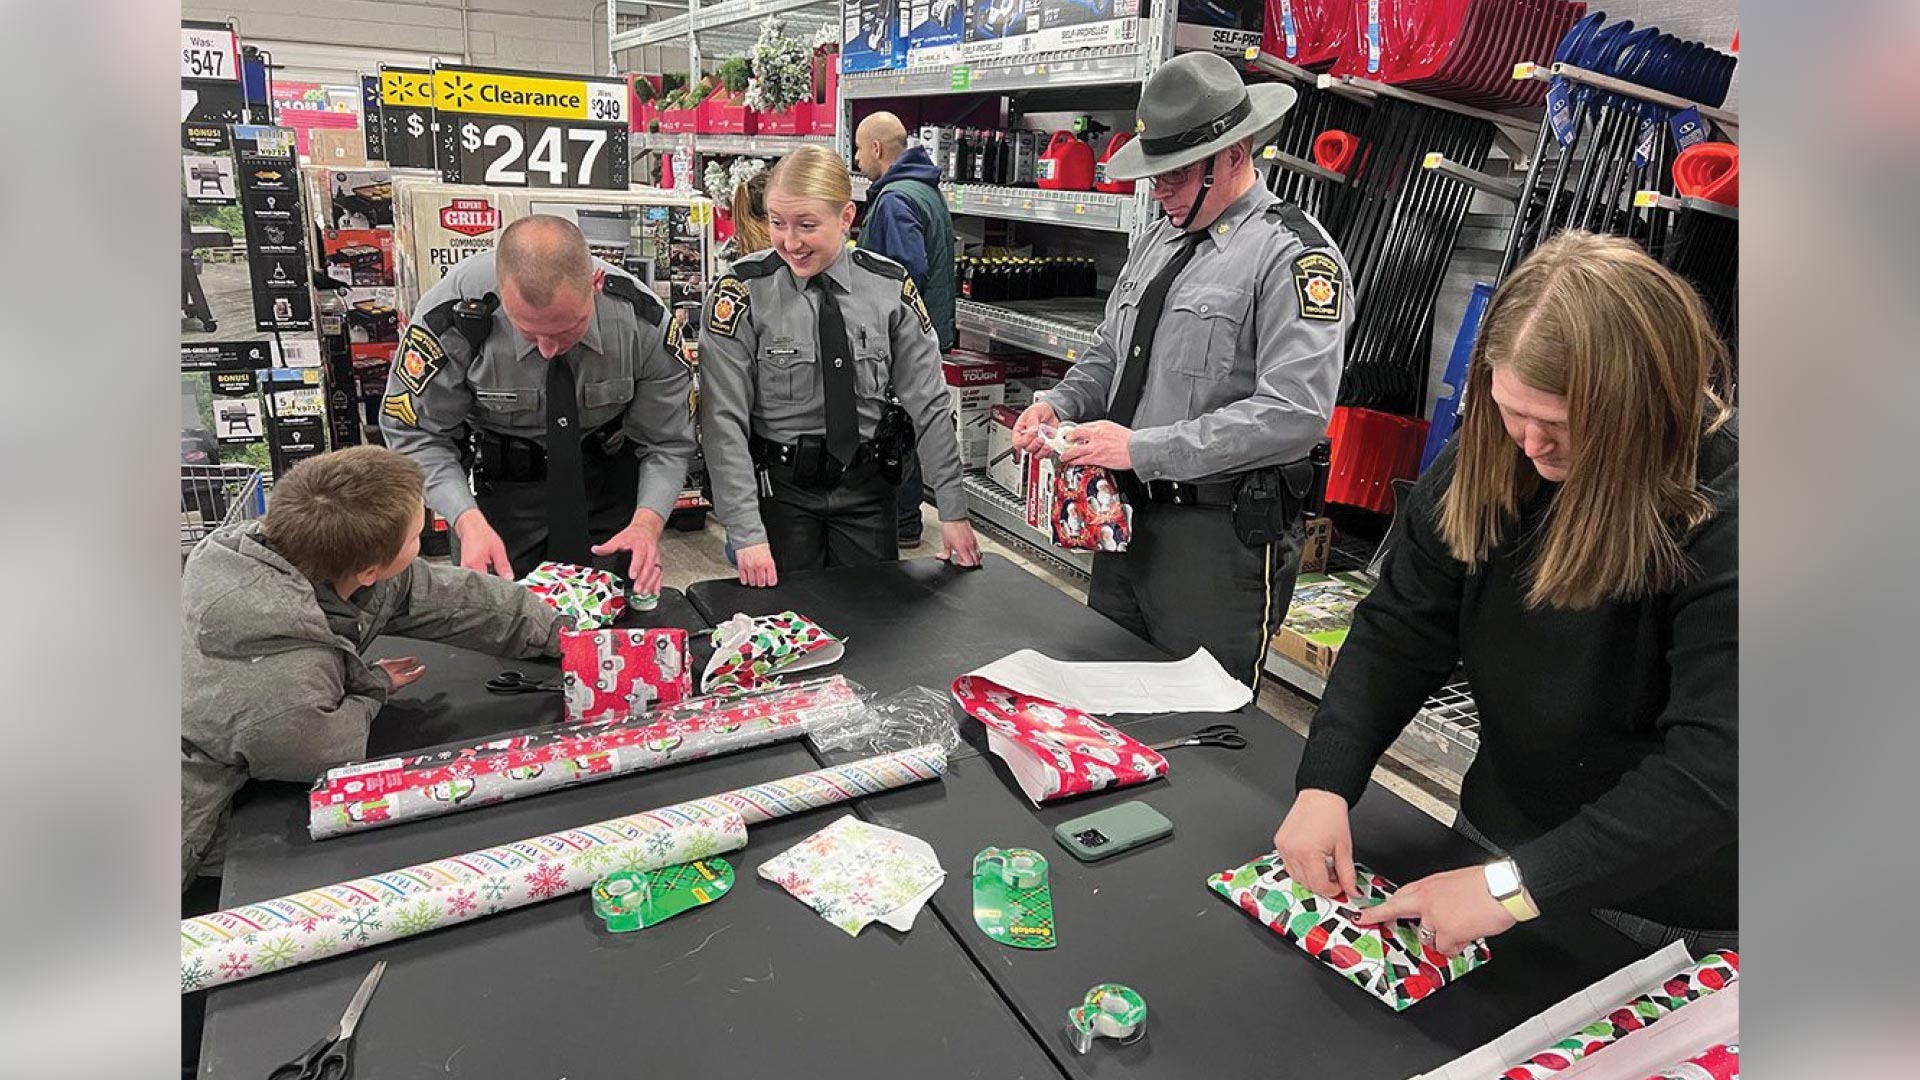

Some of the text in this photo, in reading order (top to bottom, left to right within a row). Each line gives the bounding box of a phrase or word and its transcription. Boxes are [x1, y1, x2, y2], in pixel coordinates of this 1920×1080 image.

[190, 37, 214, 47] Was:
[183, 49, 223, 76] $547
[479, 84, 580, 108] Clearance
[592, 98, 620, 120] $349
[188, 128, 221, 137] BONUS!
[461, 122, 608, 185] $247
[457, 201, 482, 209] EXPERT
[444, 211, 497, 226] GRILL
[449, 238, 494, 248] COMMODORE
[217, 374, 250, 382] BONUS!
[963, 371, 998, 381] TOUGH
[1009, 925, 1052, 936] Scotch
